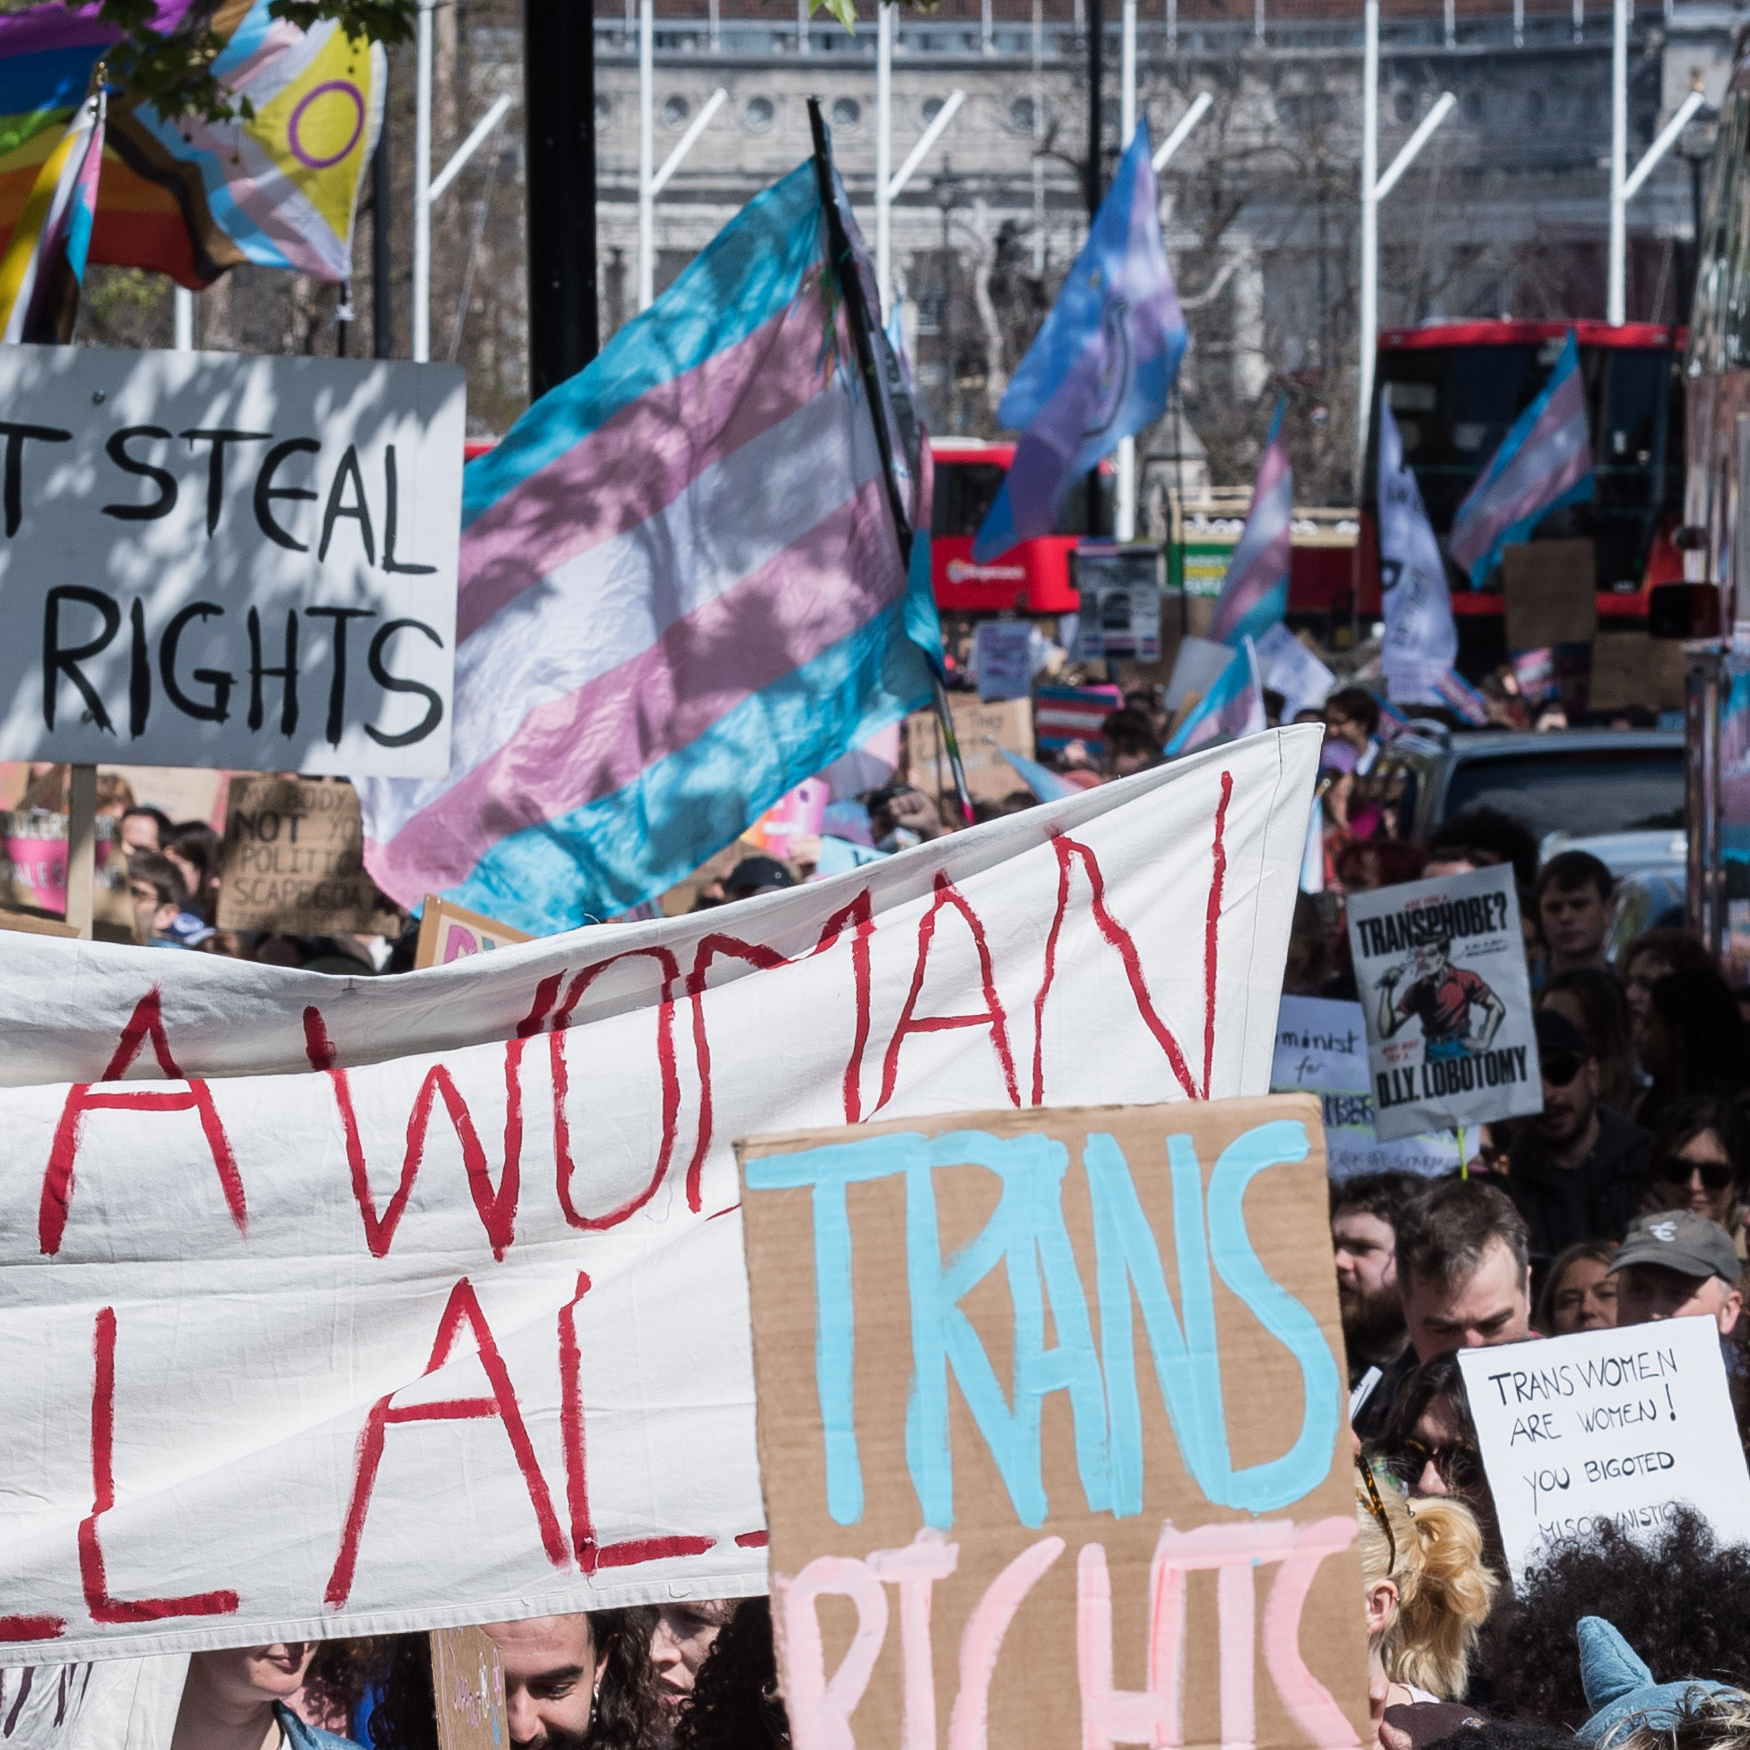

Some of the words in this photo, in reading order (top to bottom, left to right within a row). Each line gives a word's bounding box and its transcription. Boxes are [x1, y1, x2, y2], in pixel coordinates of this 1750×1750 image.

[100, 423, 438, 575] STEAL
[40, 585, 447, 751] RIGHTS
[233, 809, 309, 845] NOT
[1356, 890, 1507, 958] TRANSPHOBE?
[39, 985, 250, 1256] A
[301, 770, 1233, 1262] WOMAN
[1421, 1044, 1528, 1099] LOBOTOMY
[742, 1119, 1341, 1530] TRANS
[1488, 1360, 1576, 1407] TRANS
[1576, 1346, 1679, 1394] WOMEN
[1509, 1408, 1563, 1448] ARE
[1523, 1465, 1571, 1517] YOU
[1584, 1450, 1676, 1487] BIGOTED
